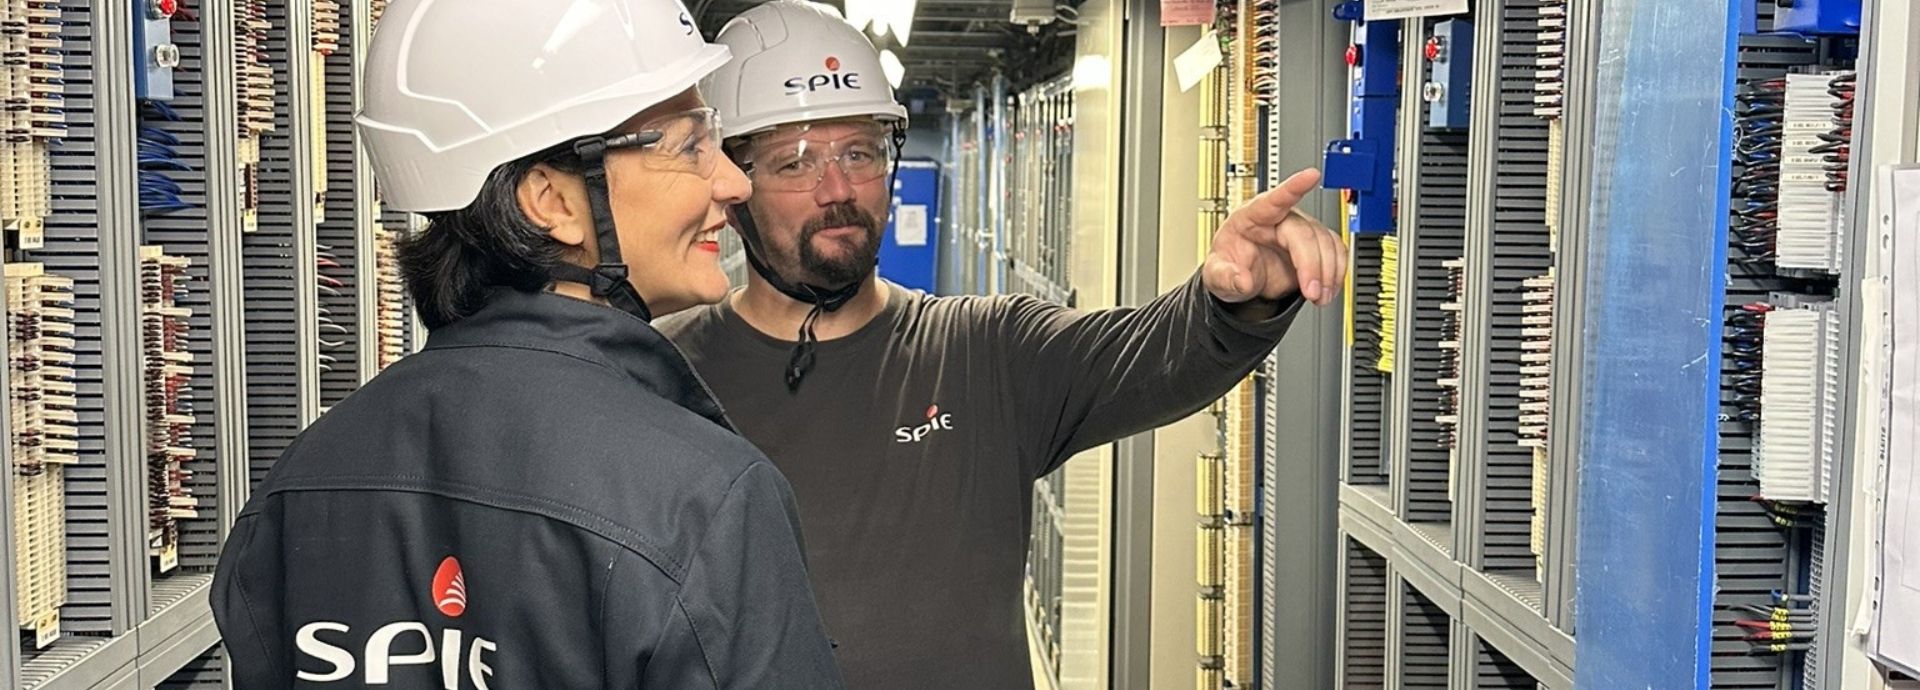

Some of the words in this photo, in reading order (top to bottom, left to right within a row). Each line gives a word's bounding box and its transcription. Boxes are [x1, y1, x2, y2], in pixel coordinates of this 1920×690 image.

[784, 73, 861, 96] SPIE
[895, 413, 953, 442] SPIE
[295, 621, 497, 690] SPIE
